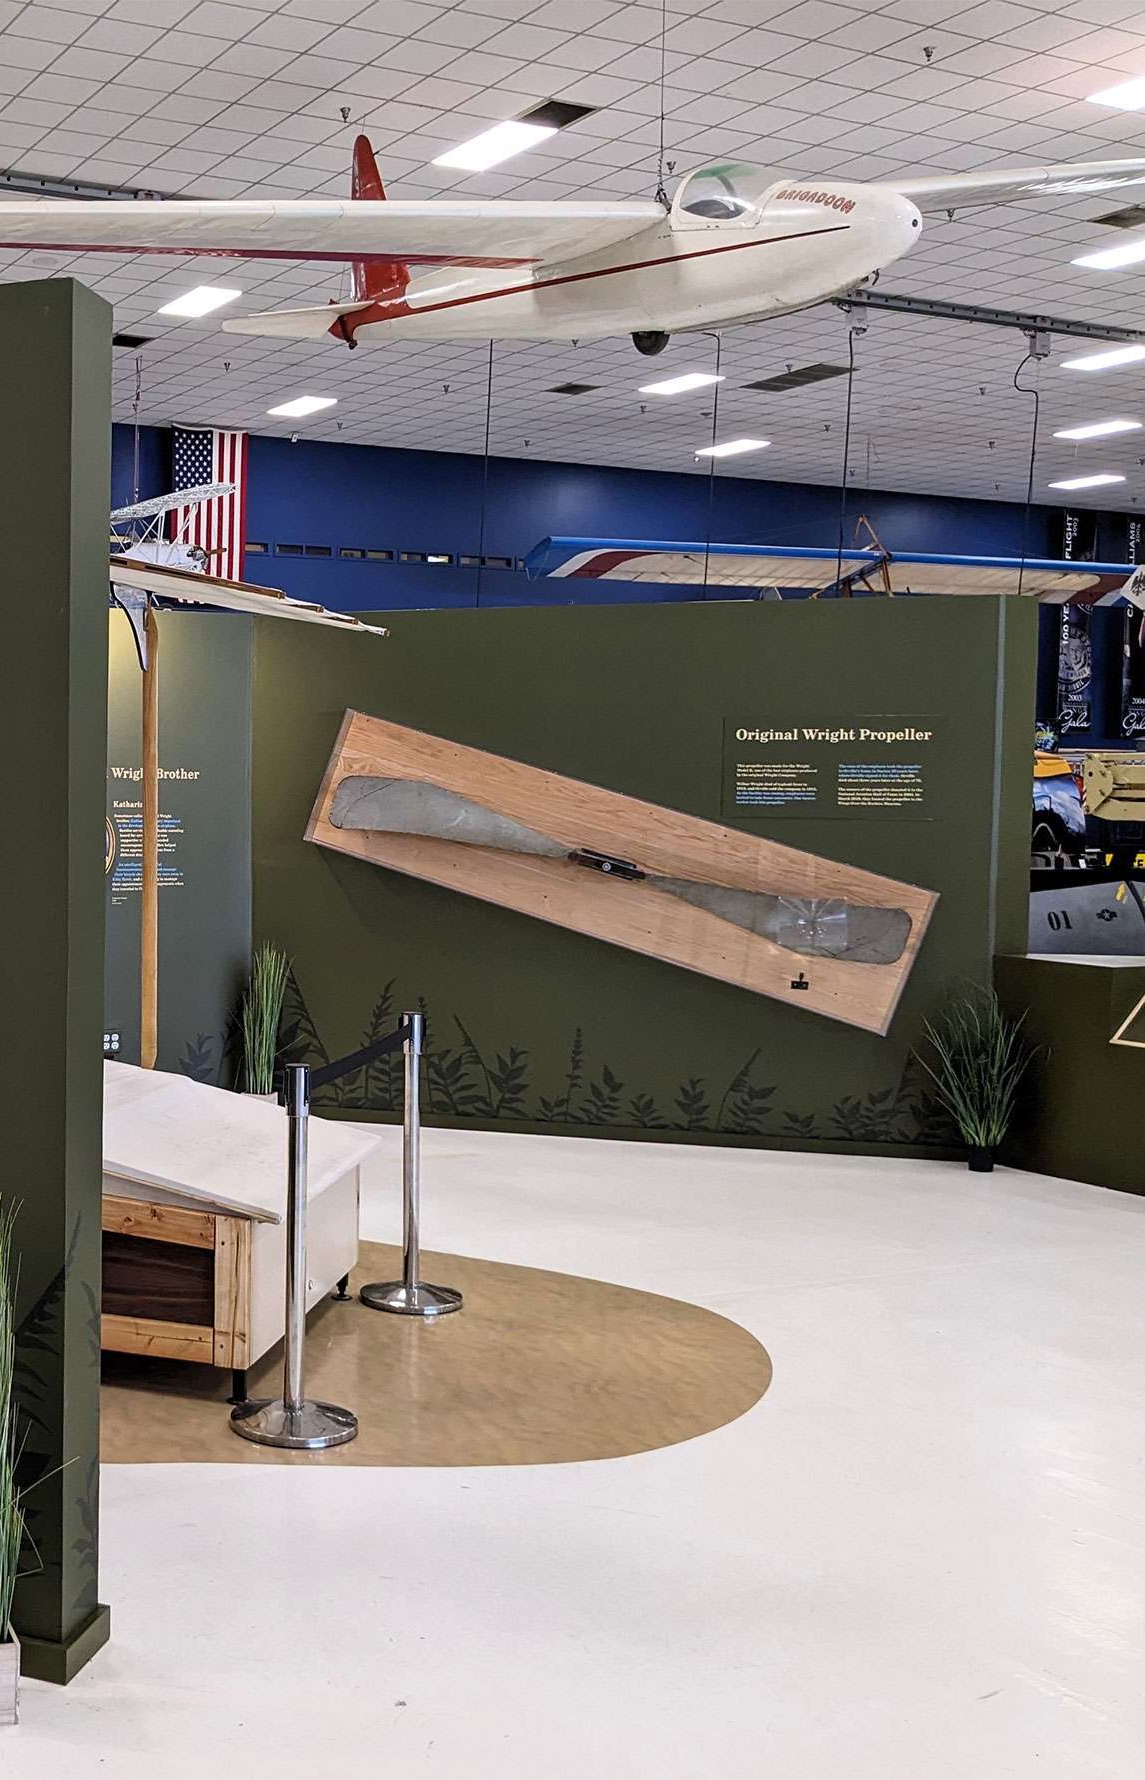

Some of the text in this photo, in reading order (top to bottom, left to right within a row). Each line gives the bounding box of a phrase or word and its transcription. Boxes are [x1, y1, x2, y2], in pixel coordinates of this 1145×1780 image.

[1065, 514, 1073, 559] FLIGHT
[1058, 710, 1090, 733] Gala
[736, 729, 932, 743] Original Wright Propeller
[1047, 910, 1073, 931] 01
